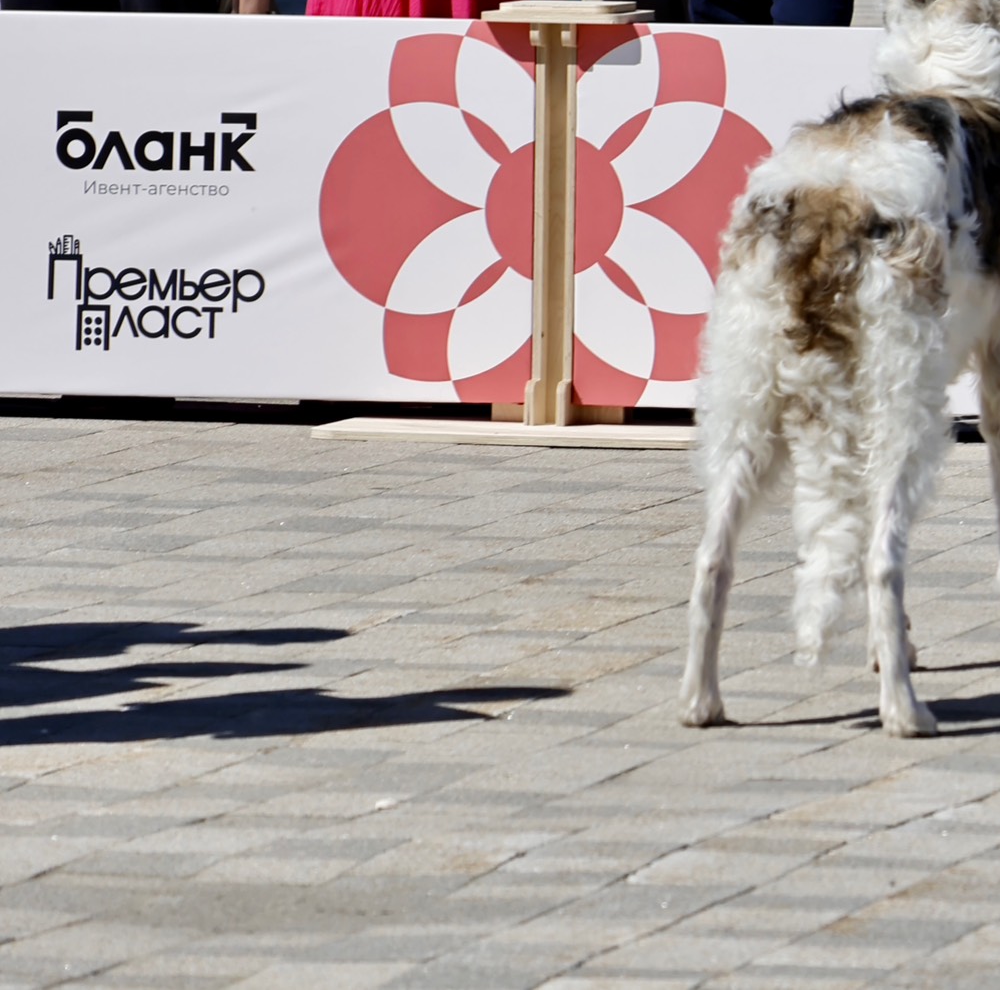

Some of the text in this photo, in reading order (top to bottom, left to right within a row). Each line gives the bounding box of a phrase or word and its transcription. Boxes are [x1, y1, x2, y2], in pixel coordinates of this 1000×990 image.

[56, 110, 257, 172] бланк
[83, 180, 230, 197] Ивент-агенство
[47, 253, 266, 313] Премьер
[75, 304, 224, 351] Пласт
